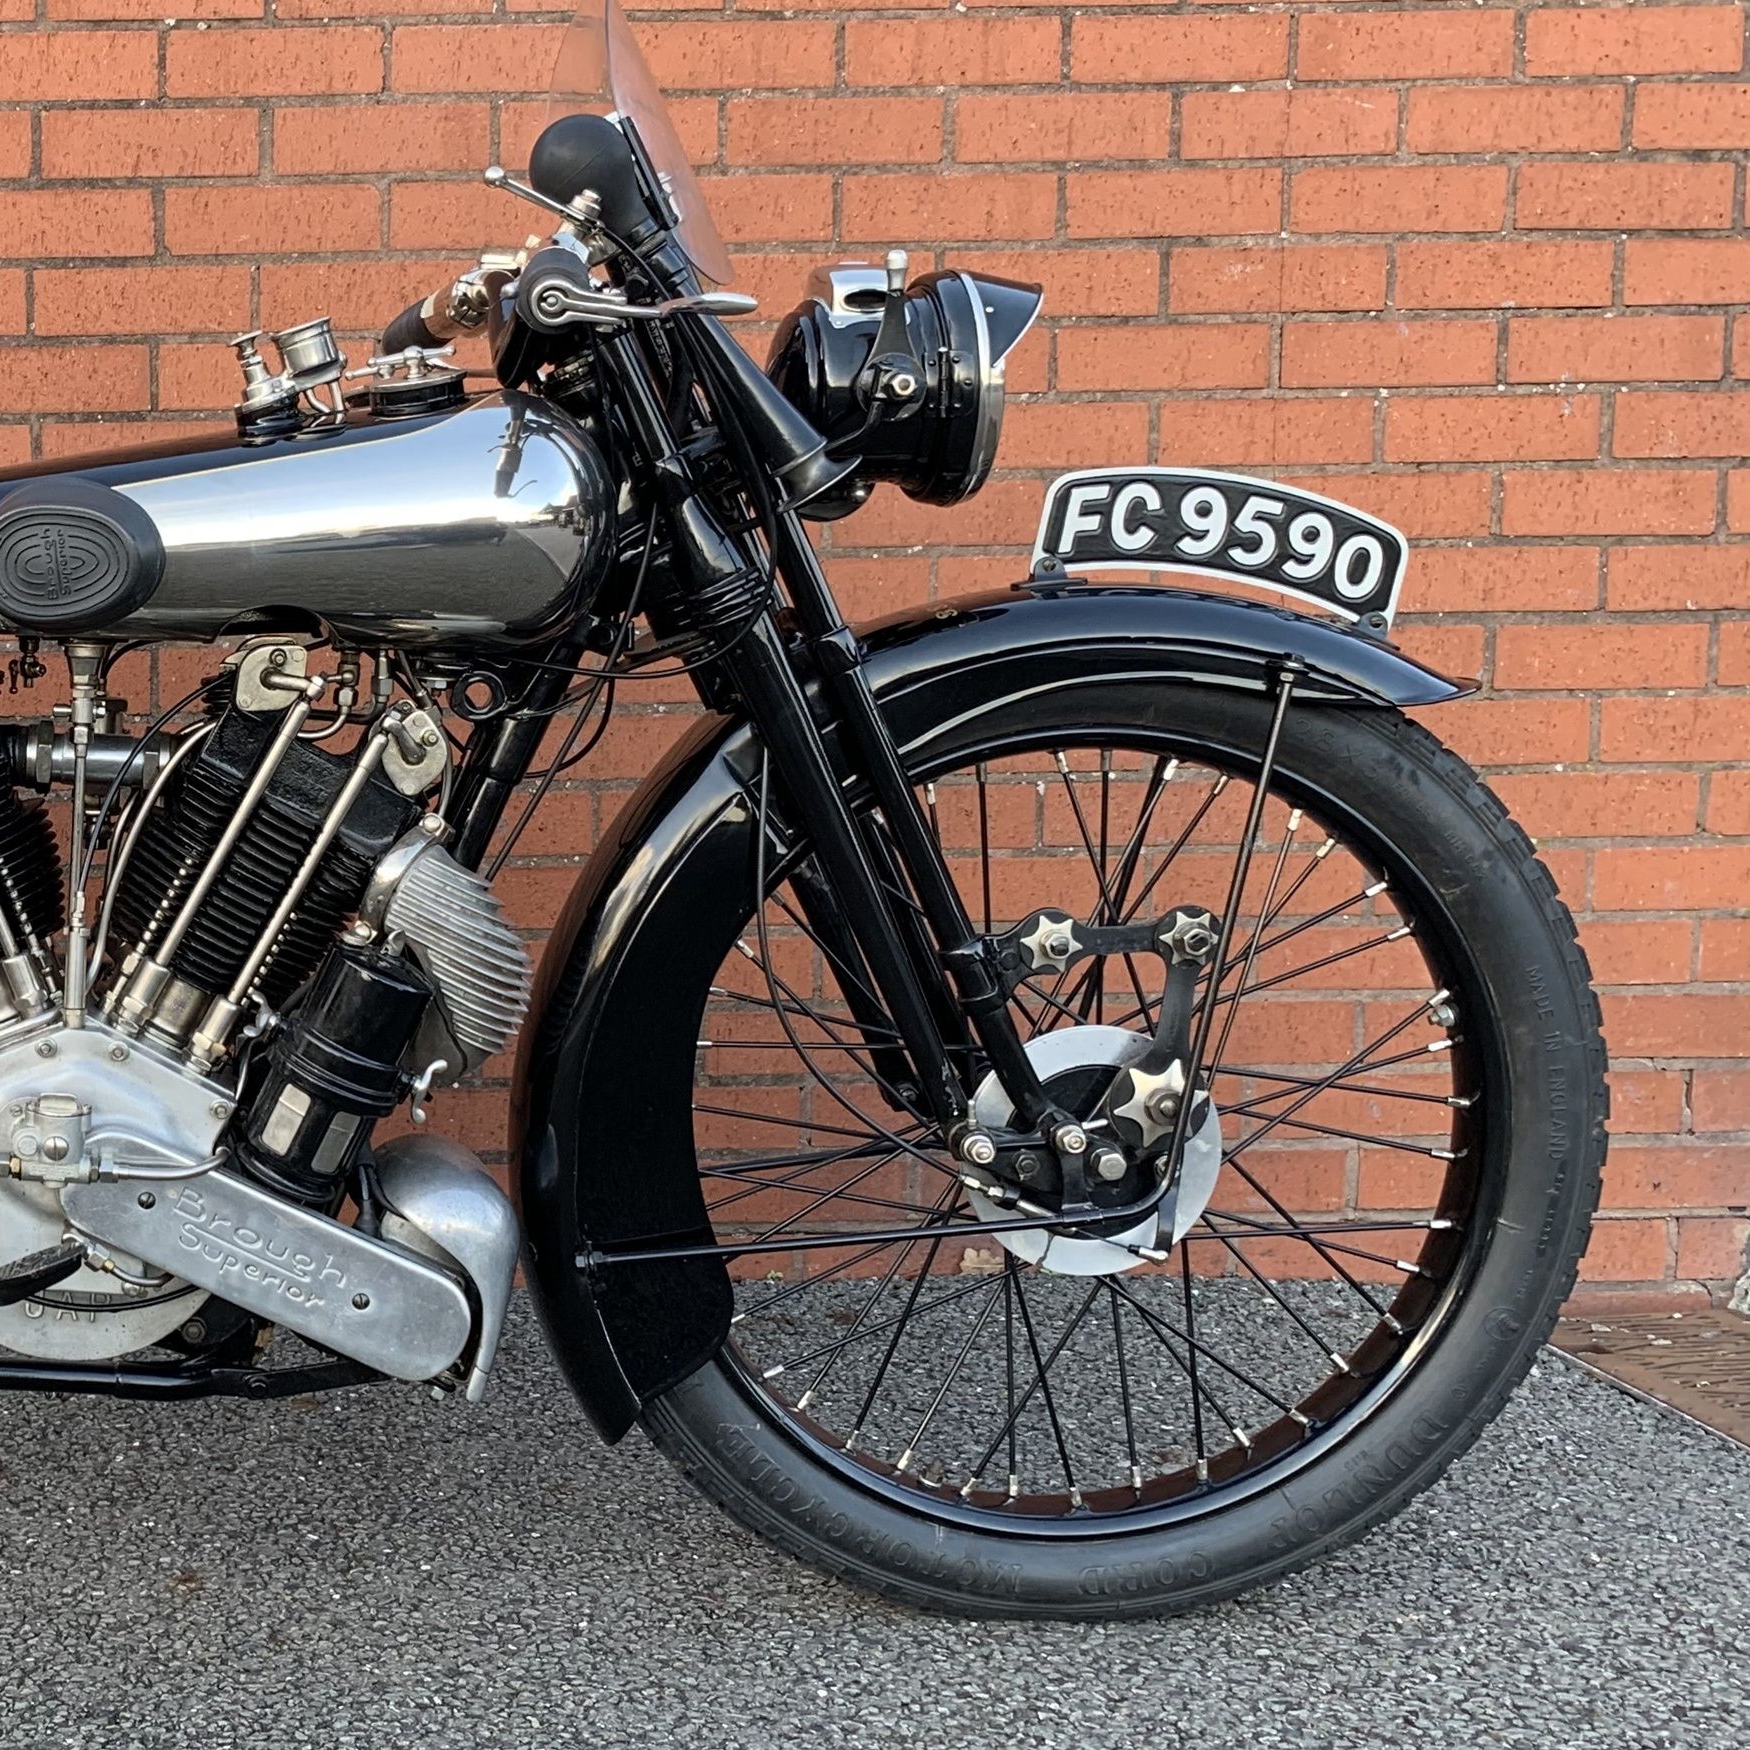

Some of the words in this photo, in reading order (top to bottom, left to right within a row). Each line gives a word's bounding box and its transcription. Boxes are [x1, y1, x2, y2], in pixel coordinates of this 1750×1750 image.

[40, 528, 59, 600] Brough
[57, 529, 73, 595] Superior
[1057, 481, 1164, 553] FC
[1173, 486, 1383, 600] 9590
[1525, 965, 1554, 1021] MADE
[1544, 1030, 1562, 1053] IN
[1549, 1064, 1567, 1160] ENGLAND
[172, 1187, 347, 1289] Brough
[178, 1222, 325, 1308] Superior
[714, 1424, 1023, 1594] MOTORCYCLE
[1266, 1410, 1450, 1548] DUNLOP
[1076, 1550, 1215, 1596] CORD
